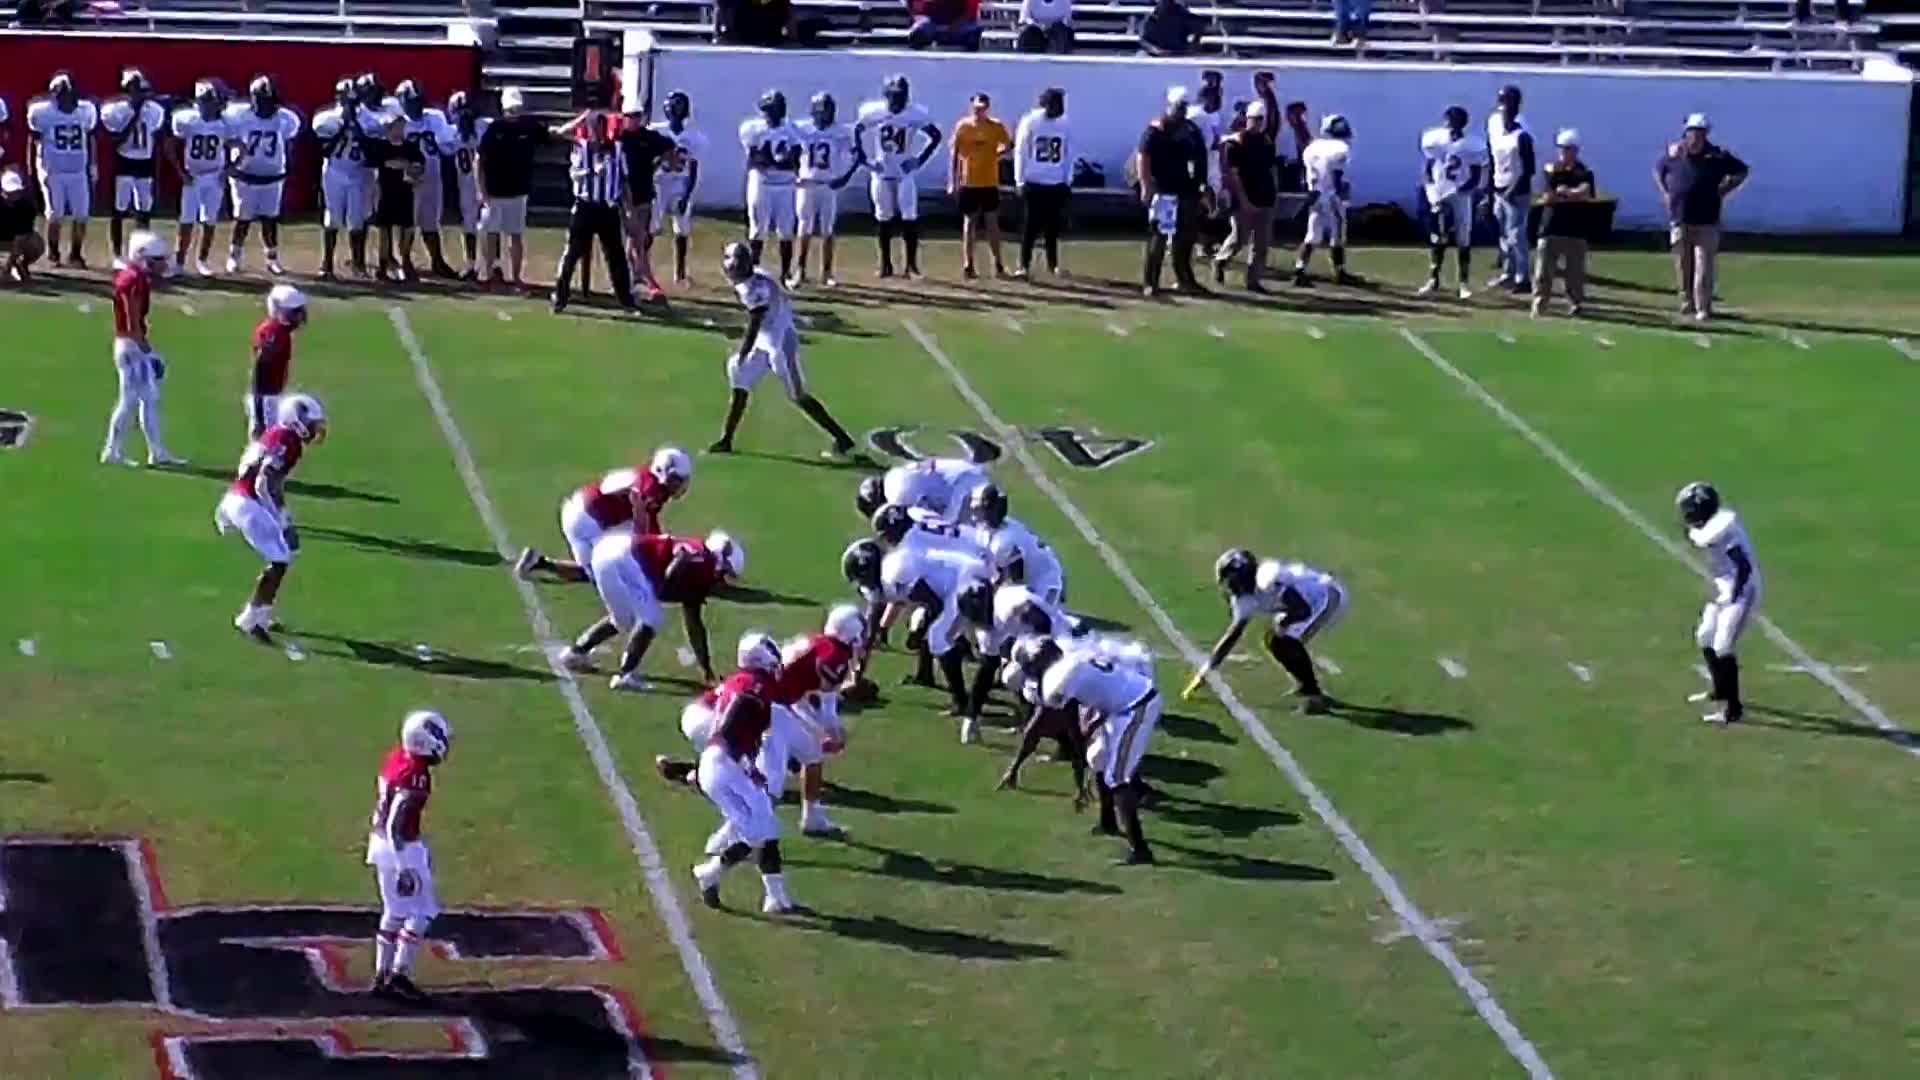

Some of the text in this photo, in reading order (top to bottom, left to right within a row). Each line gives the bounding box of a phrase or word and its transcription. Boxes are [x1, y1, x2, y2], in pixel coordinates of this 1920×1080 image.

[249, 131, 277, 157] 73
[880, 126, 906, 154] 24
[809, 142, 831, 169] 13
